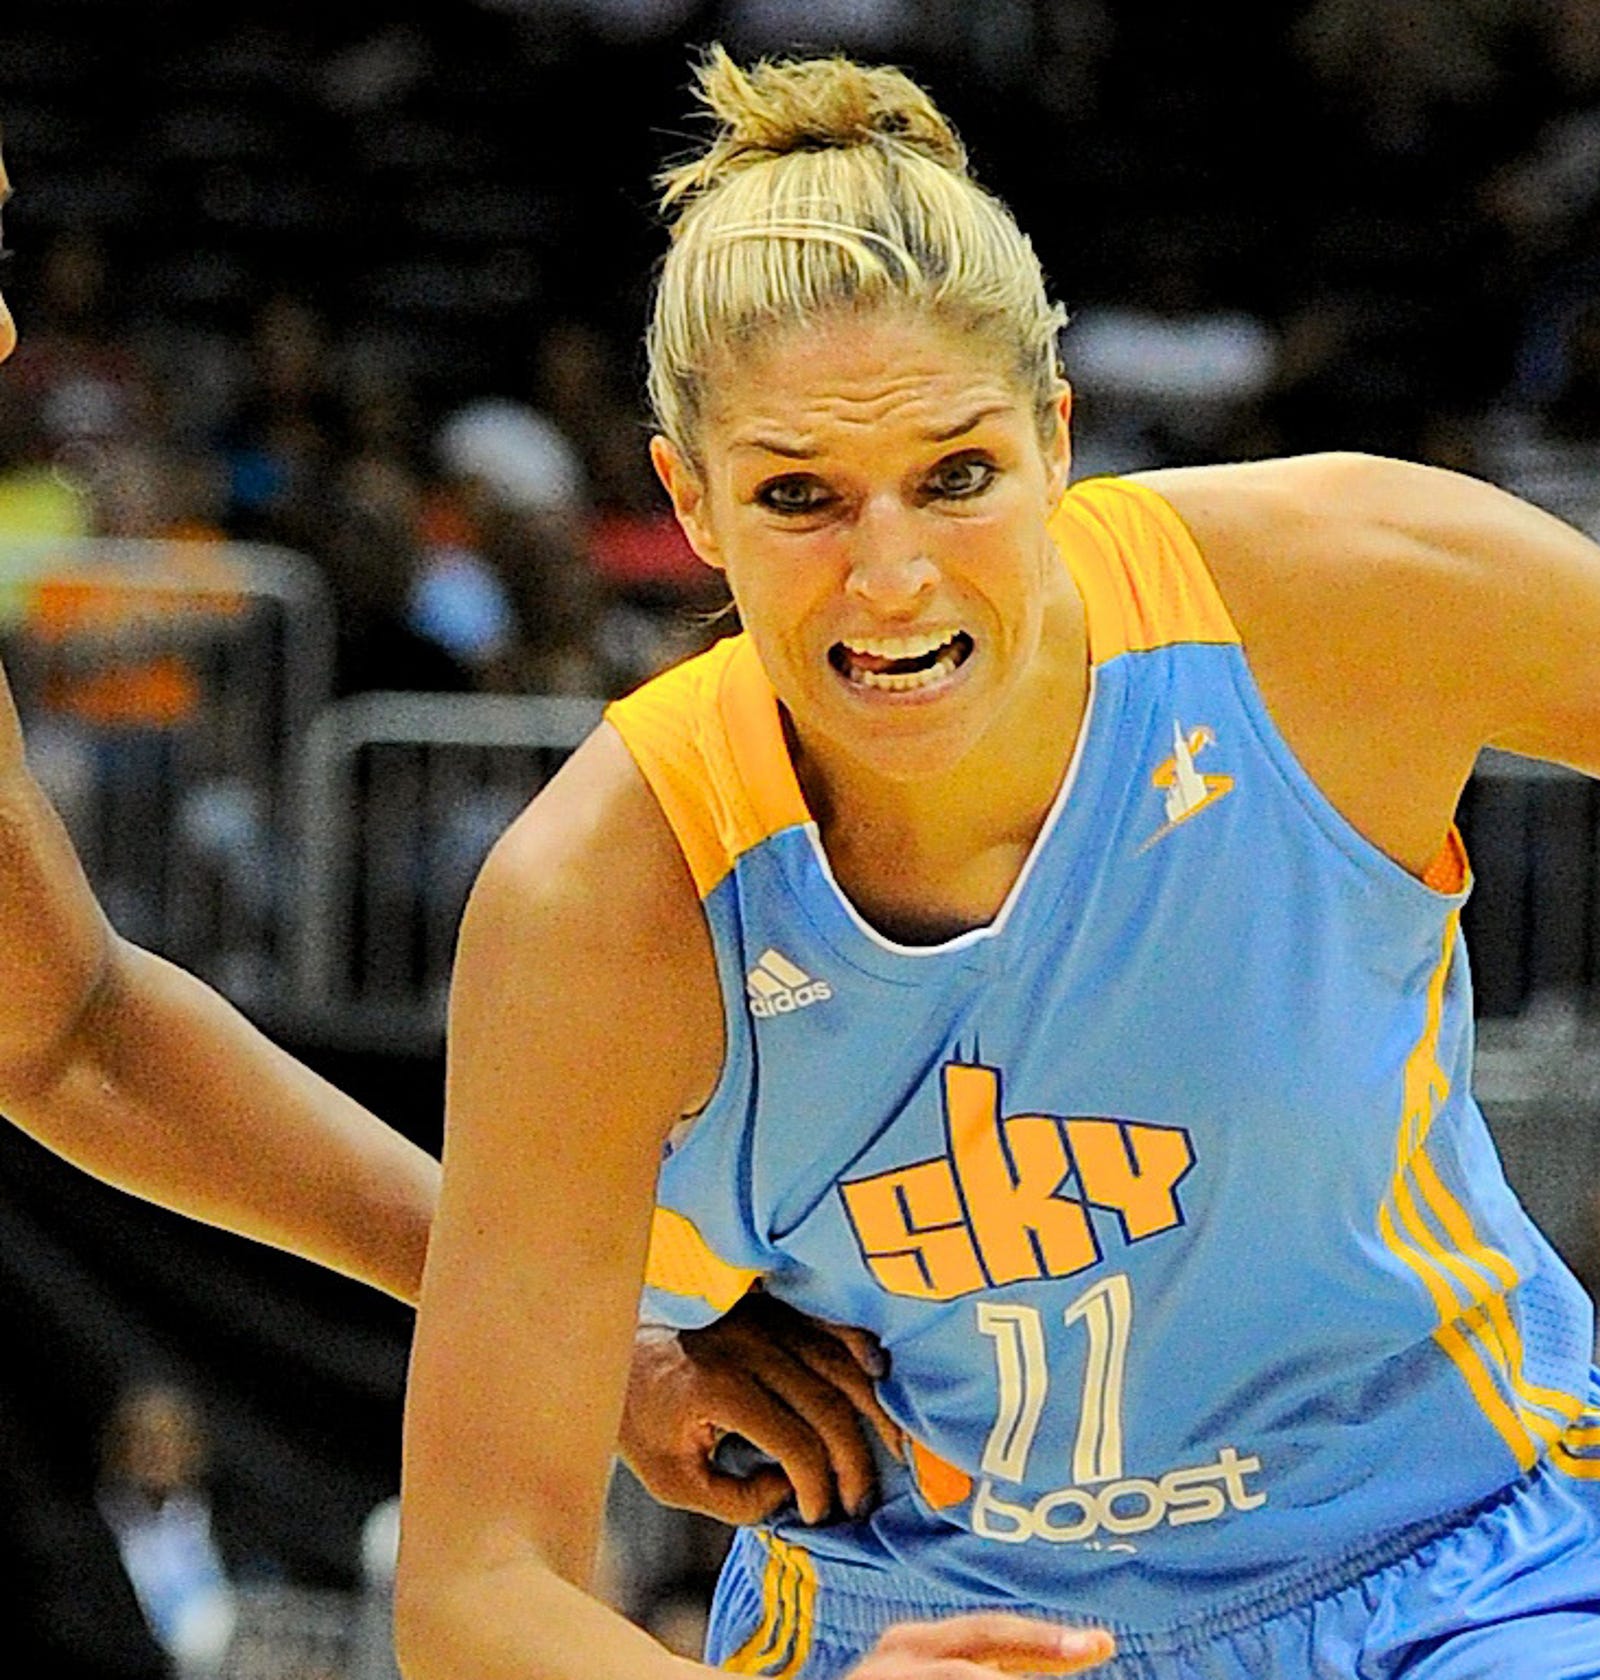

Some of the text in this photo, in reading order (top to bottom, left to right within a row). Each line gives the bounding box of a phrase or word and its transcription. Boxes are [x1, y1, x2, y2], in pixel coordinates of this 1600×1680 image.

[750, 981, 832, 1017] adidas
[976, 1274, 1132, 1484] 11
[972, 1448, 1266, 1542] boost
